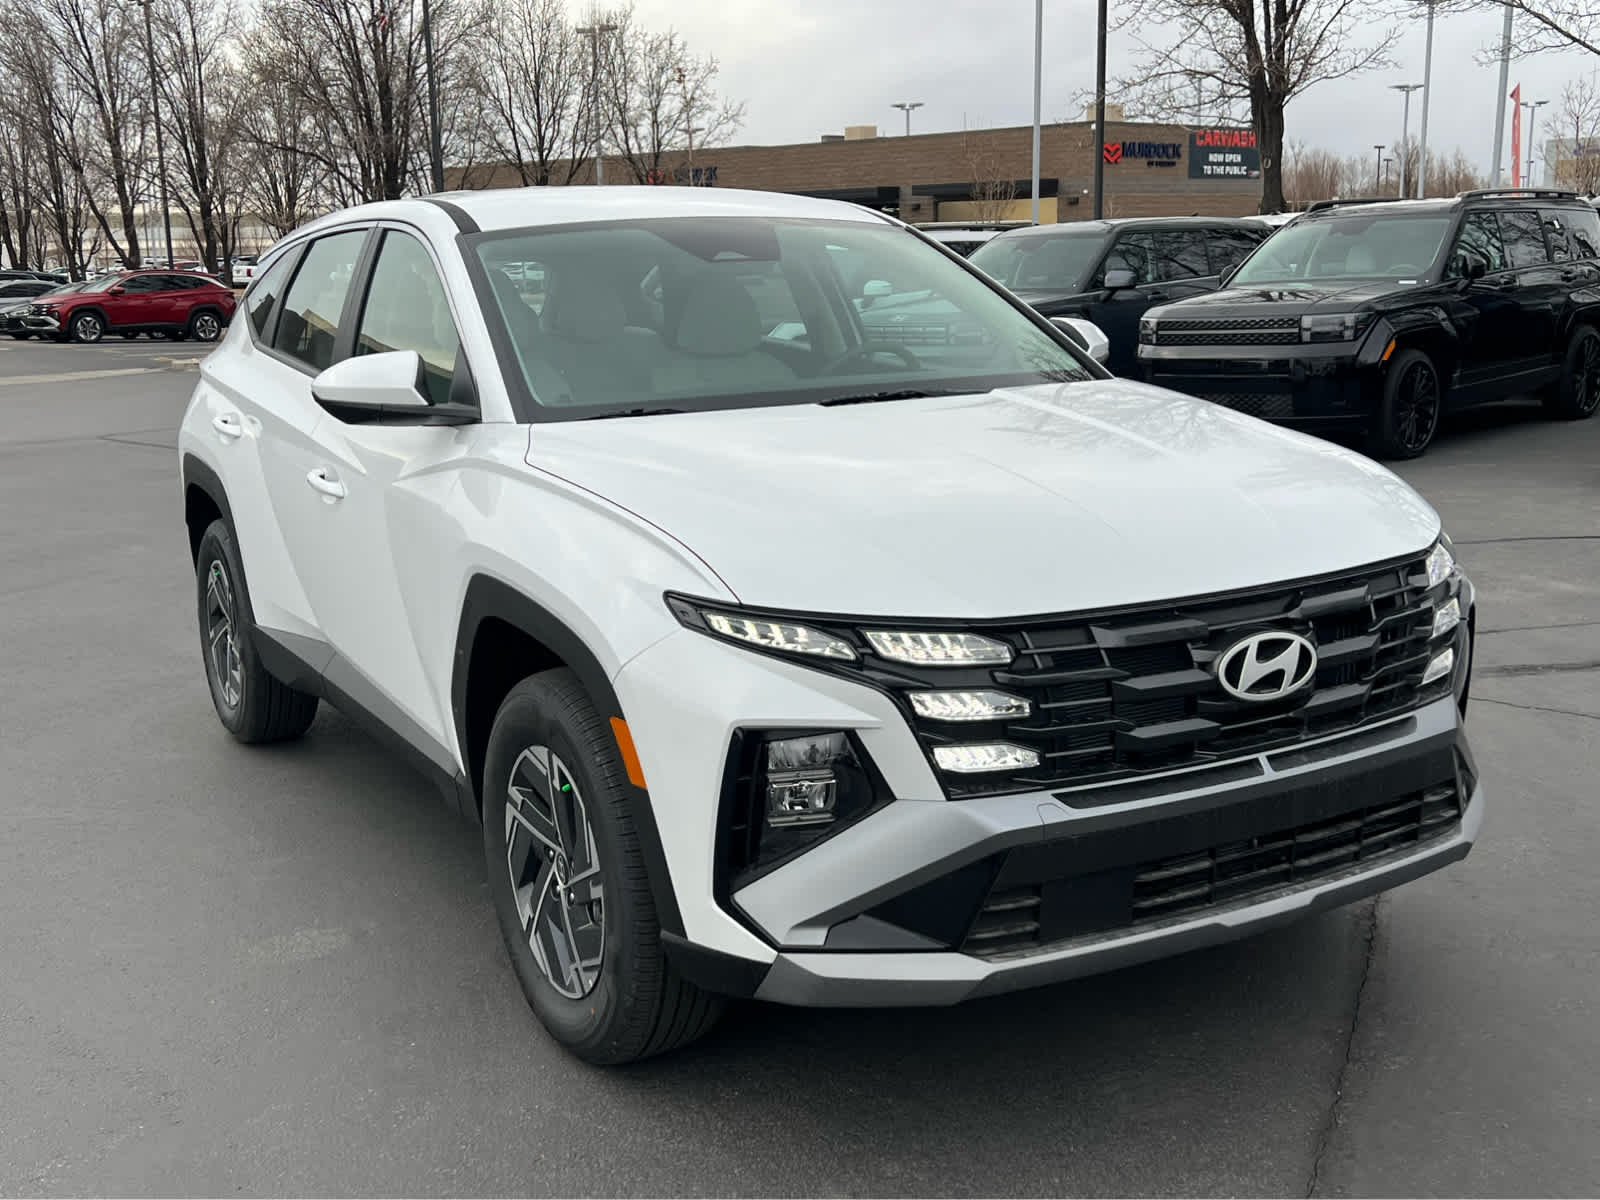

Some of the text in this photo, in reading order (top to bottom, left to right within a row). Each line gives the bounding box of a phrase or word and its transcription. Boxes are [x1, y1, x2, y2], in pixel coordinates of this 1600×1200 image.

[1122, 142, 1182, 158] MURDOCK
[1208, 153, 1241, 162] NOW OPEN
[1203, 165, 1212, 175] TO
[1213, 165, 1224, 175] THE
[1225, 165, 1247, 175] PUBLIC
